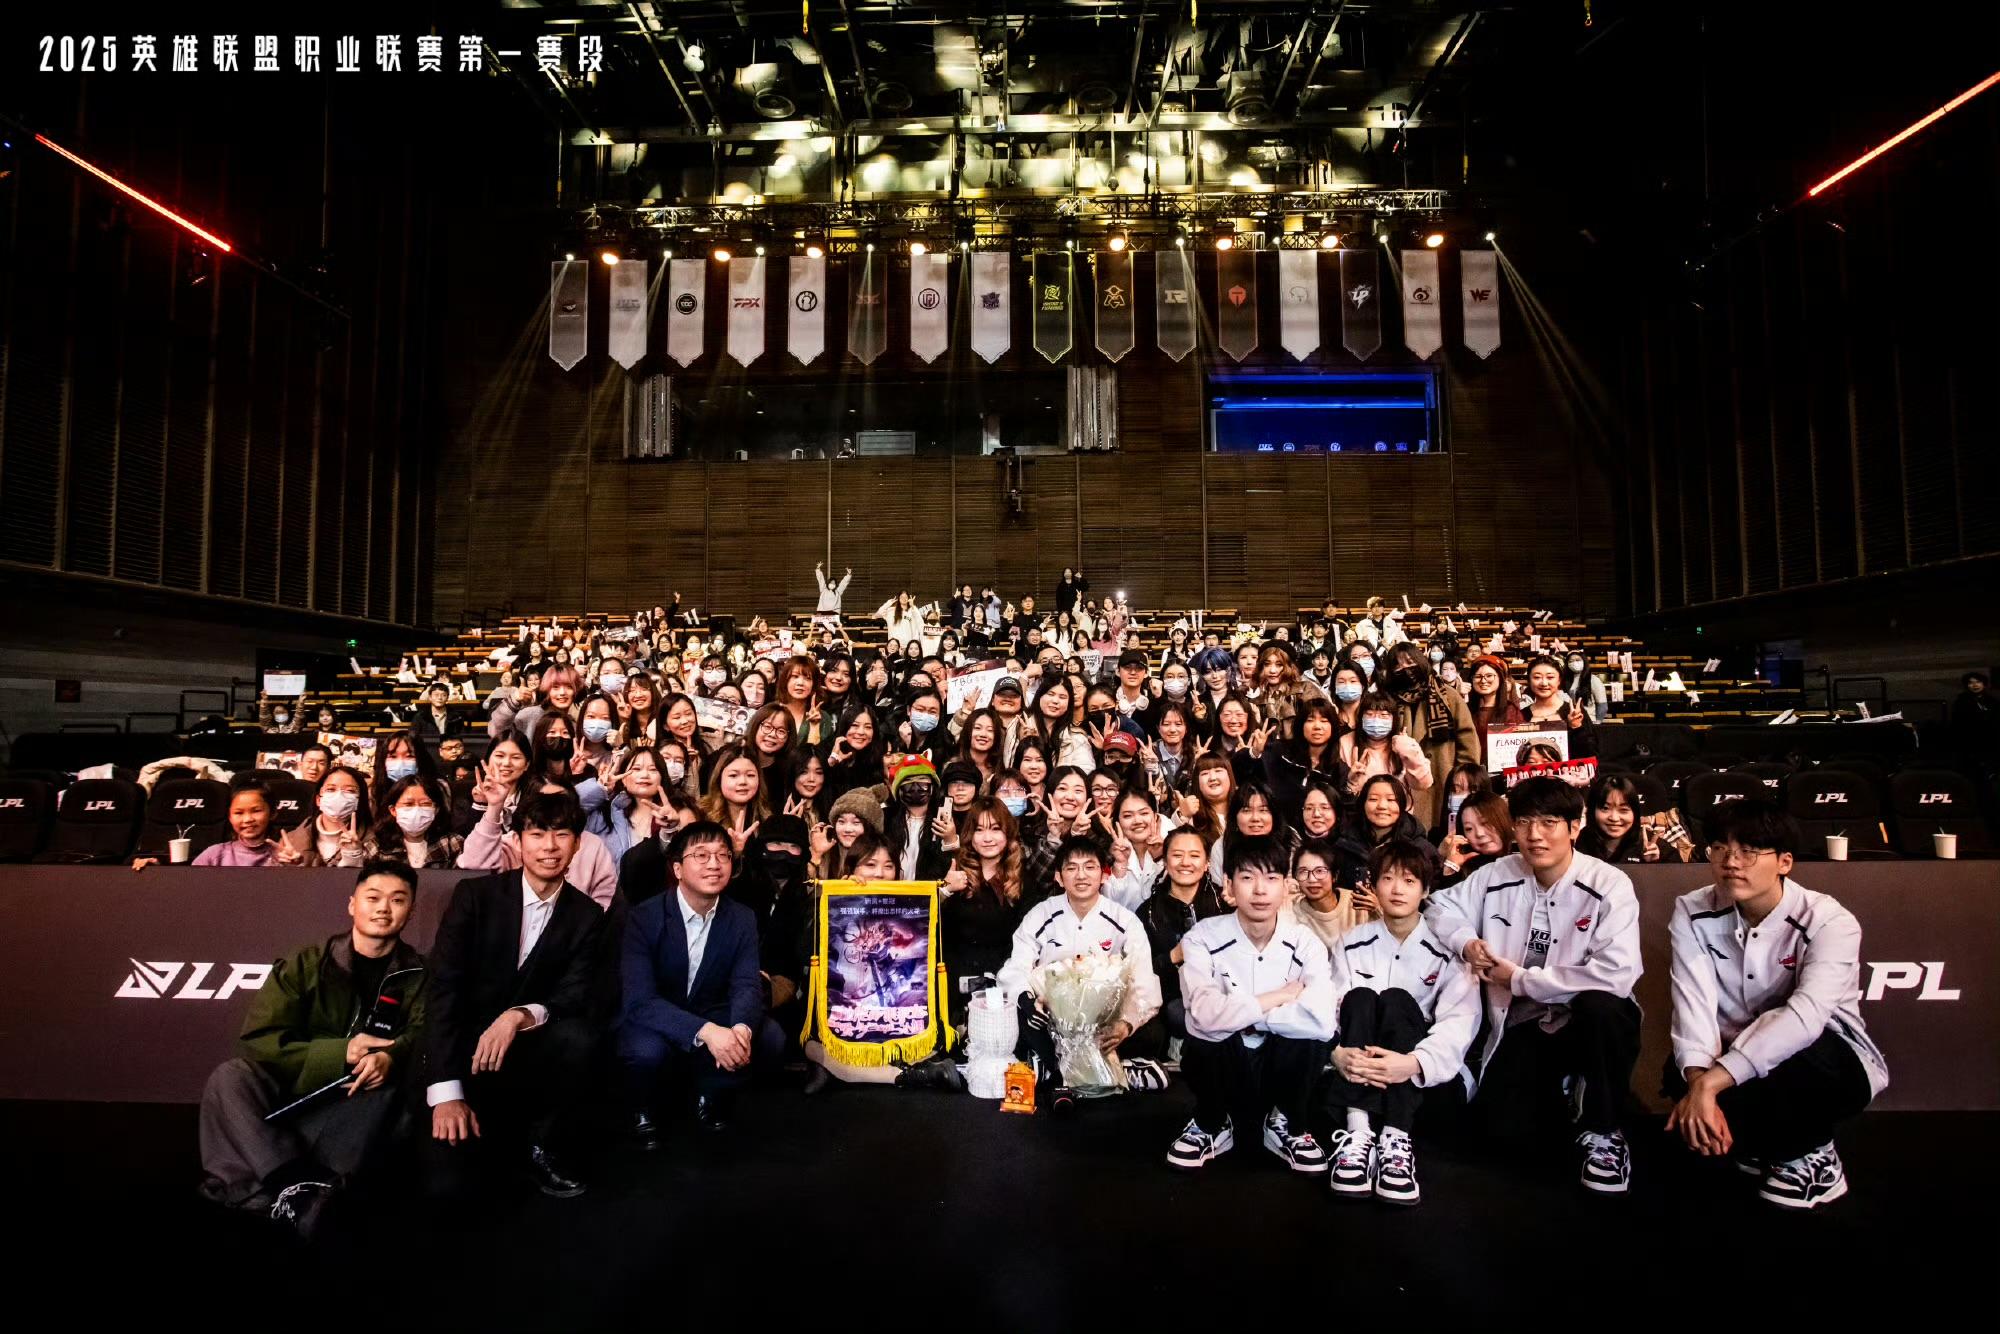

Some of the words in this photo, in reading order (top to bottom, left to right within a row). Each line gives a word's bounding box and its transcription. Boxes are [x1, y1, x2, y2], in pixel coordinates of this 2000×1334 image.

[1470, 288, 1491, 303] WE
[733, 297, 760, 308] FPX
[1496, 738, 1527, 747] FLANDR
[1814, 793, 1848, 803] LPL
[1919, 793, 1953, 804] LPL
[84, 800, 116, 811] LPL
[174, 799, 205, 809] LPL
[277, 800, 299, 811] PL
[172, 962, 274, 1000] LP
